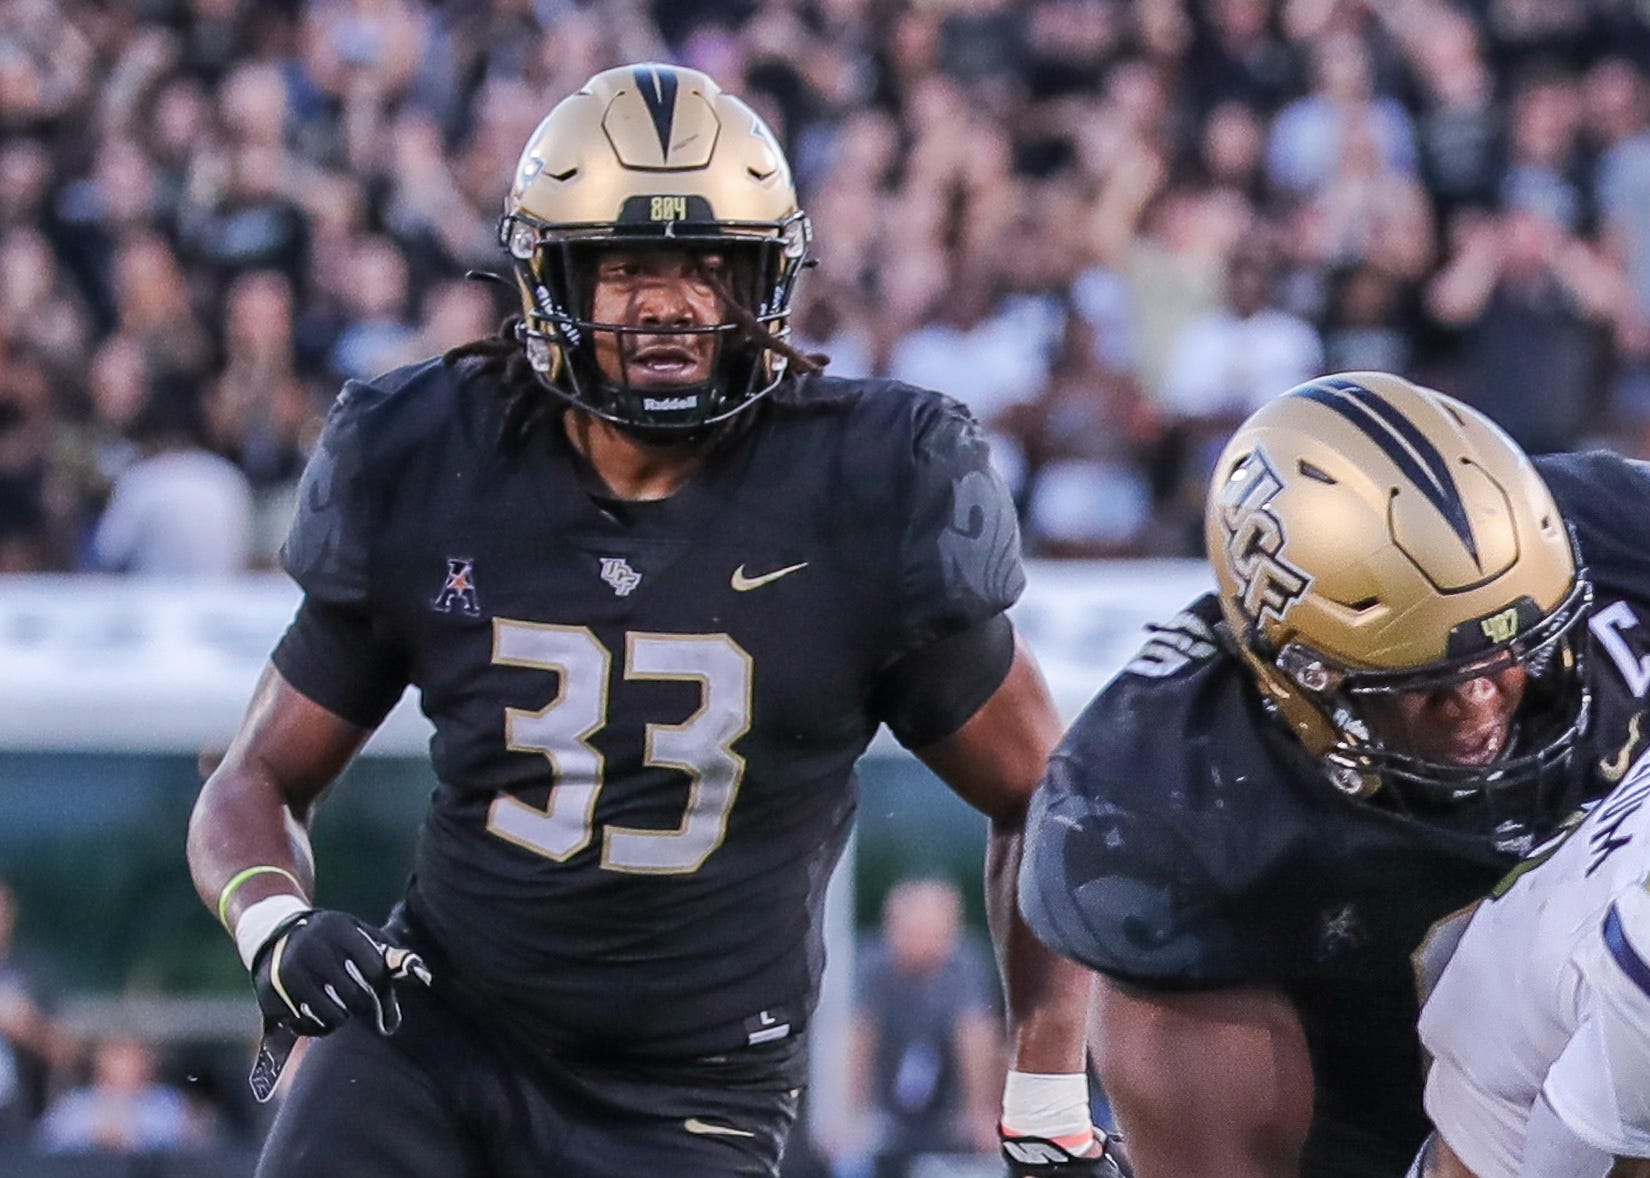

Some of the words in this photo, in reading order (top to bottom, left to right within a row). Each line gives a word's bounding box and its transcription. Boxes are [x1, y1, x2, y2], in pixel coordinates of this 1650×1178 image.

[650, 196, 687, 221] 804
[643, 395, 698, 411] Riddell
[1220, 446, 1315, 630] UCF
[600, 557, 642, 597] UCF
[486, 616, 754, 875] 33
